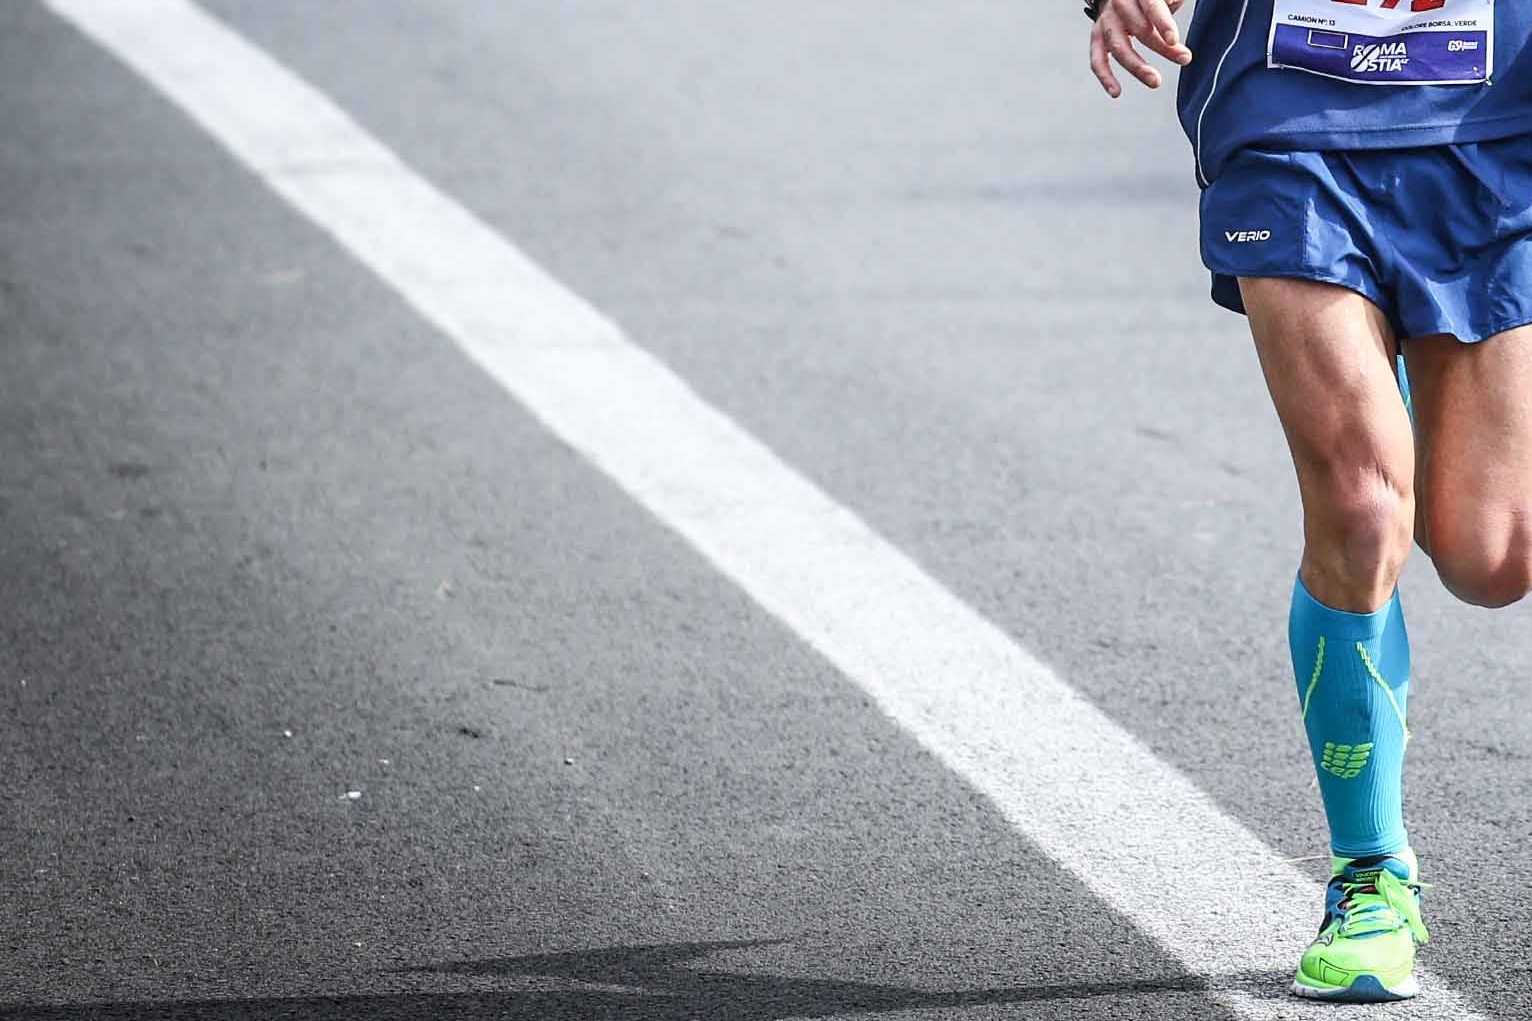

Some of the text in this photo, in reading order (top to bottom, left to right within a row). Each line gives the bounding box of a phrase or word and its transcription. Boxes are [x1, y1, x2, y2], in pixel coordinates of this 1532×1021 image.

[1287, 13, 1317, 24] CAMION
[1454, 19, 1477, 27] VERDE
[1224, 230, 1271, 243] VERIO
